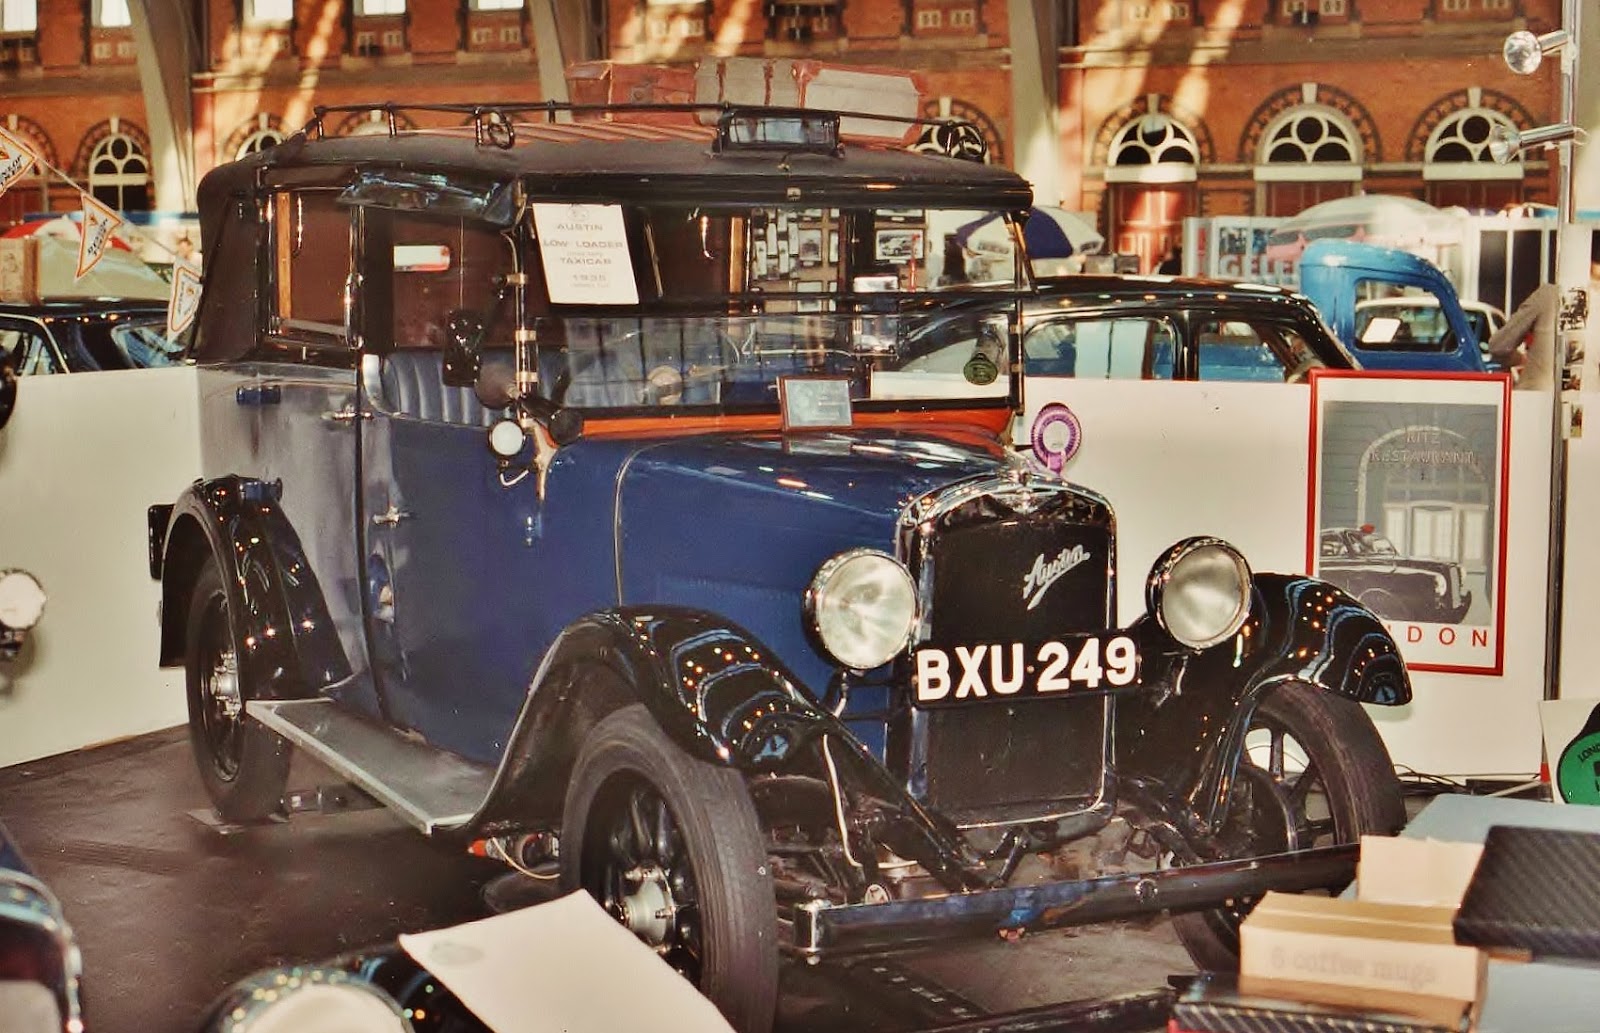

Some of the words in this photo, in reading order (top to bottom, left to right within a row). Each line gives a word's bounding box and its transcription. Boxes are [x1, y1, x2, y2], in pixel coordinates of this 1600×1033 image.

[556, 223, 603, 231] AUSTIN
[543, 239, 568, 247] LOW
[575, 240, 623, 248] LOADER
[560, 256, 612, 265] TAXICAB
[1368, 448, 1475, 464] RESTAURANT
[1023, 544, 1091, 611] Austin
[1388, 624, 1488, 647] DON
[916, 642, 1025, 701] BXU
[1037, 636, 1137, 692] 249
[1271, 946, 1285, 969] 6
[1293, 949, 1363, 977] coffee
[1370, 962, 1437, 991] mugs
